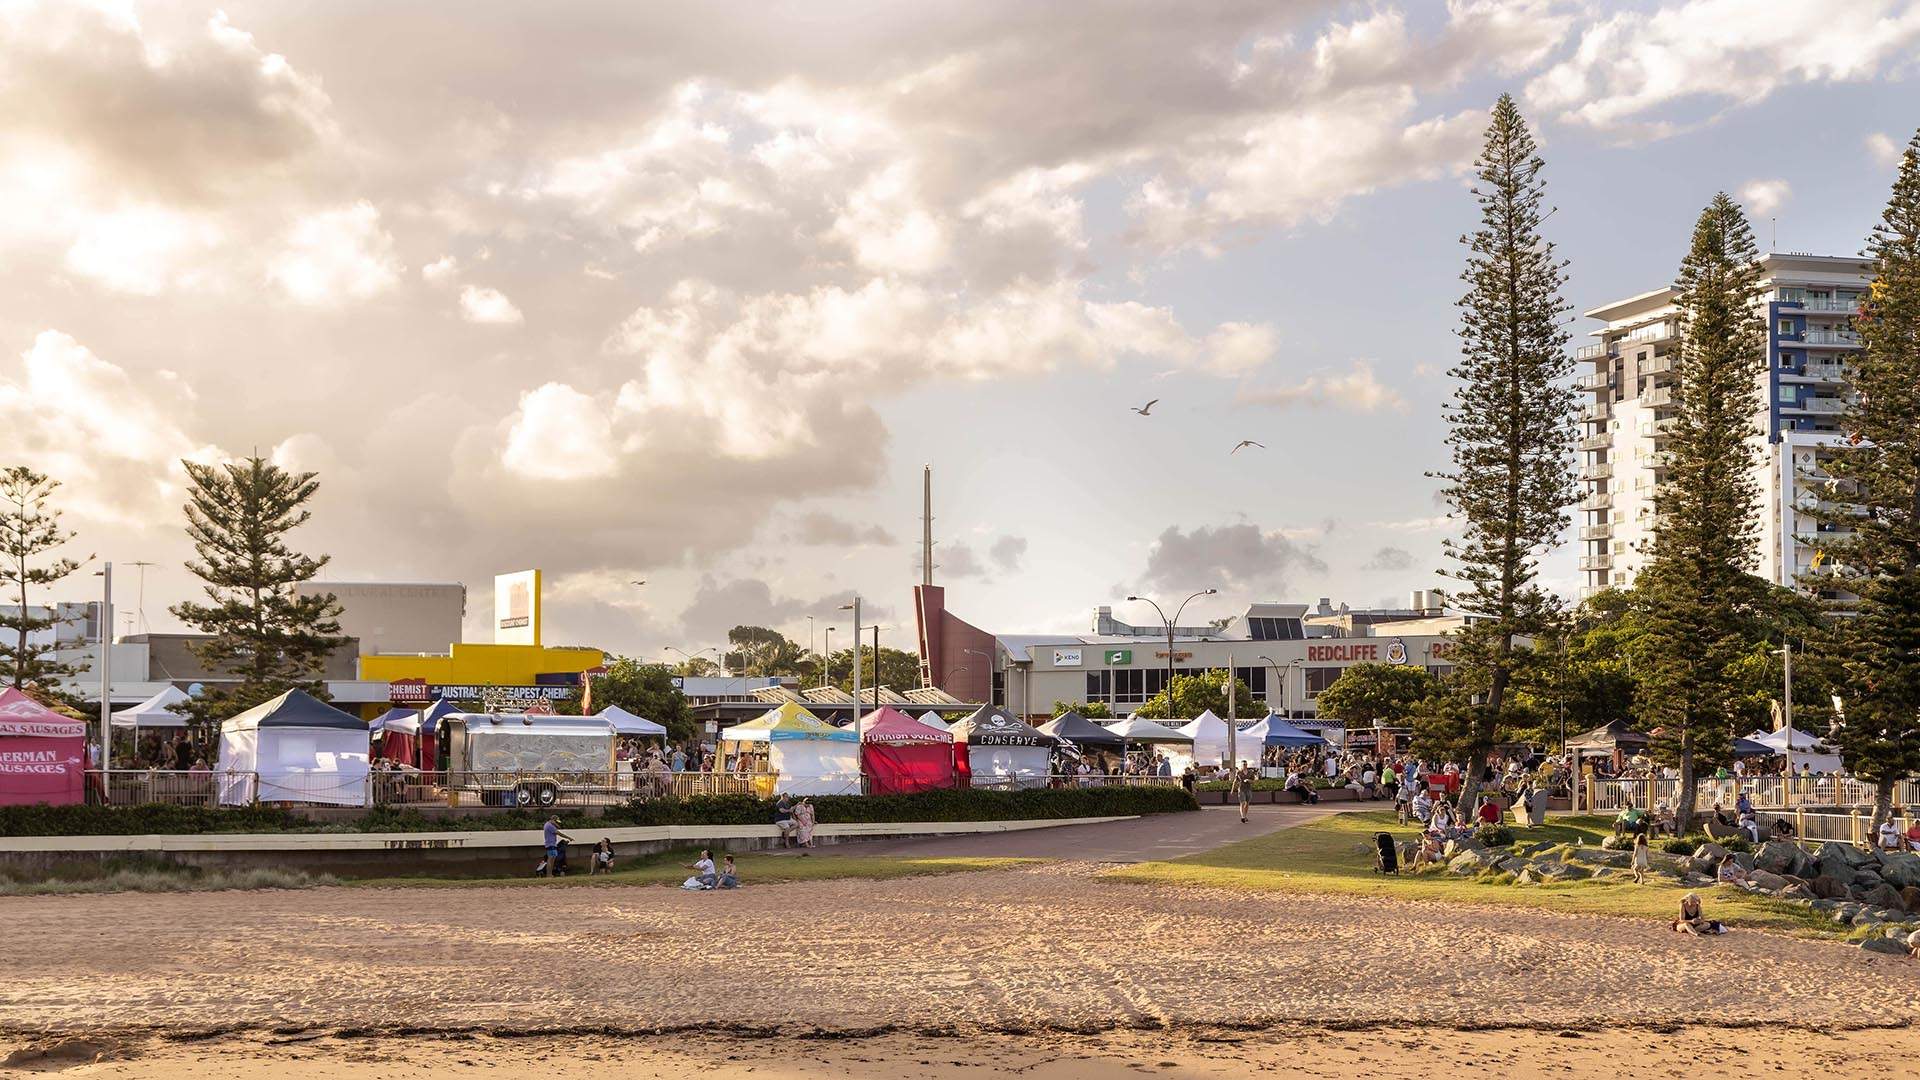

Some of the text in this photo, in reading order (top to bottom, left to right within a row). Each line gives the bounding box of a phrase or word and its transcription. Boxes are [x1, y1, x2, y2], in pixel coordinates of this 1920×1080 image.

[1308, 645, 1377, 661] REDCLIFFE
[389, 685, 427, 694] CHEMIST
[20, 724, 84, 734] SAUSAGES
[981, 735, 1038, 746] CONSERVE
[0, 751, 56, 763] ERMAN
